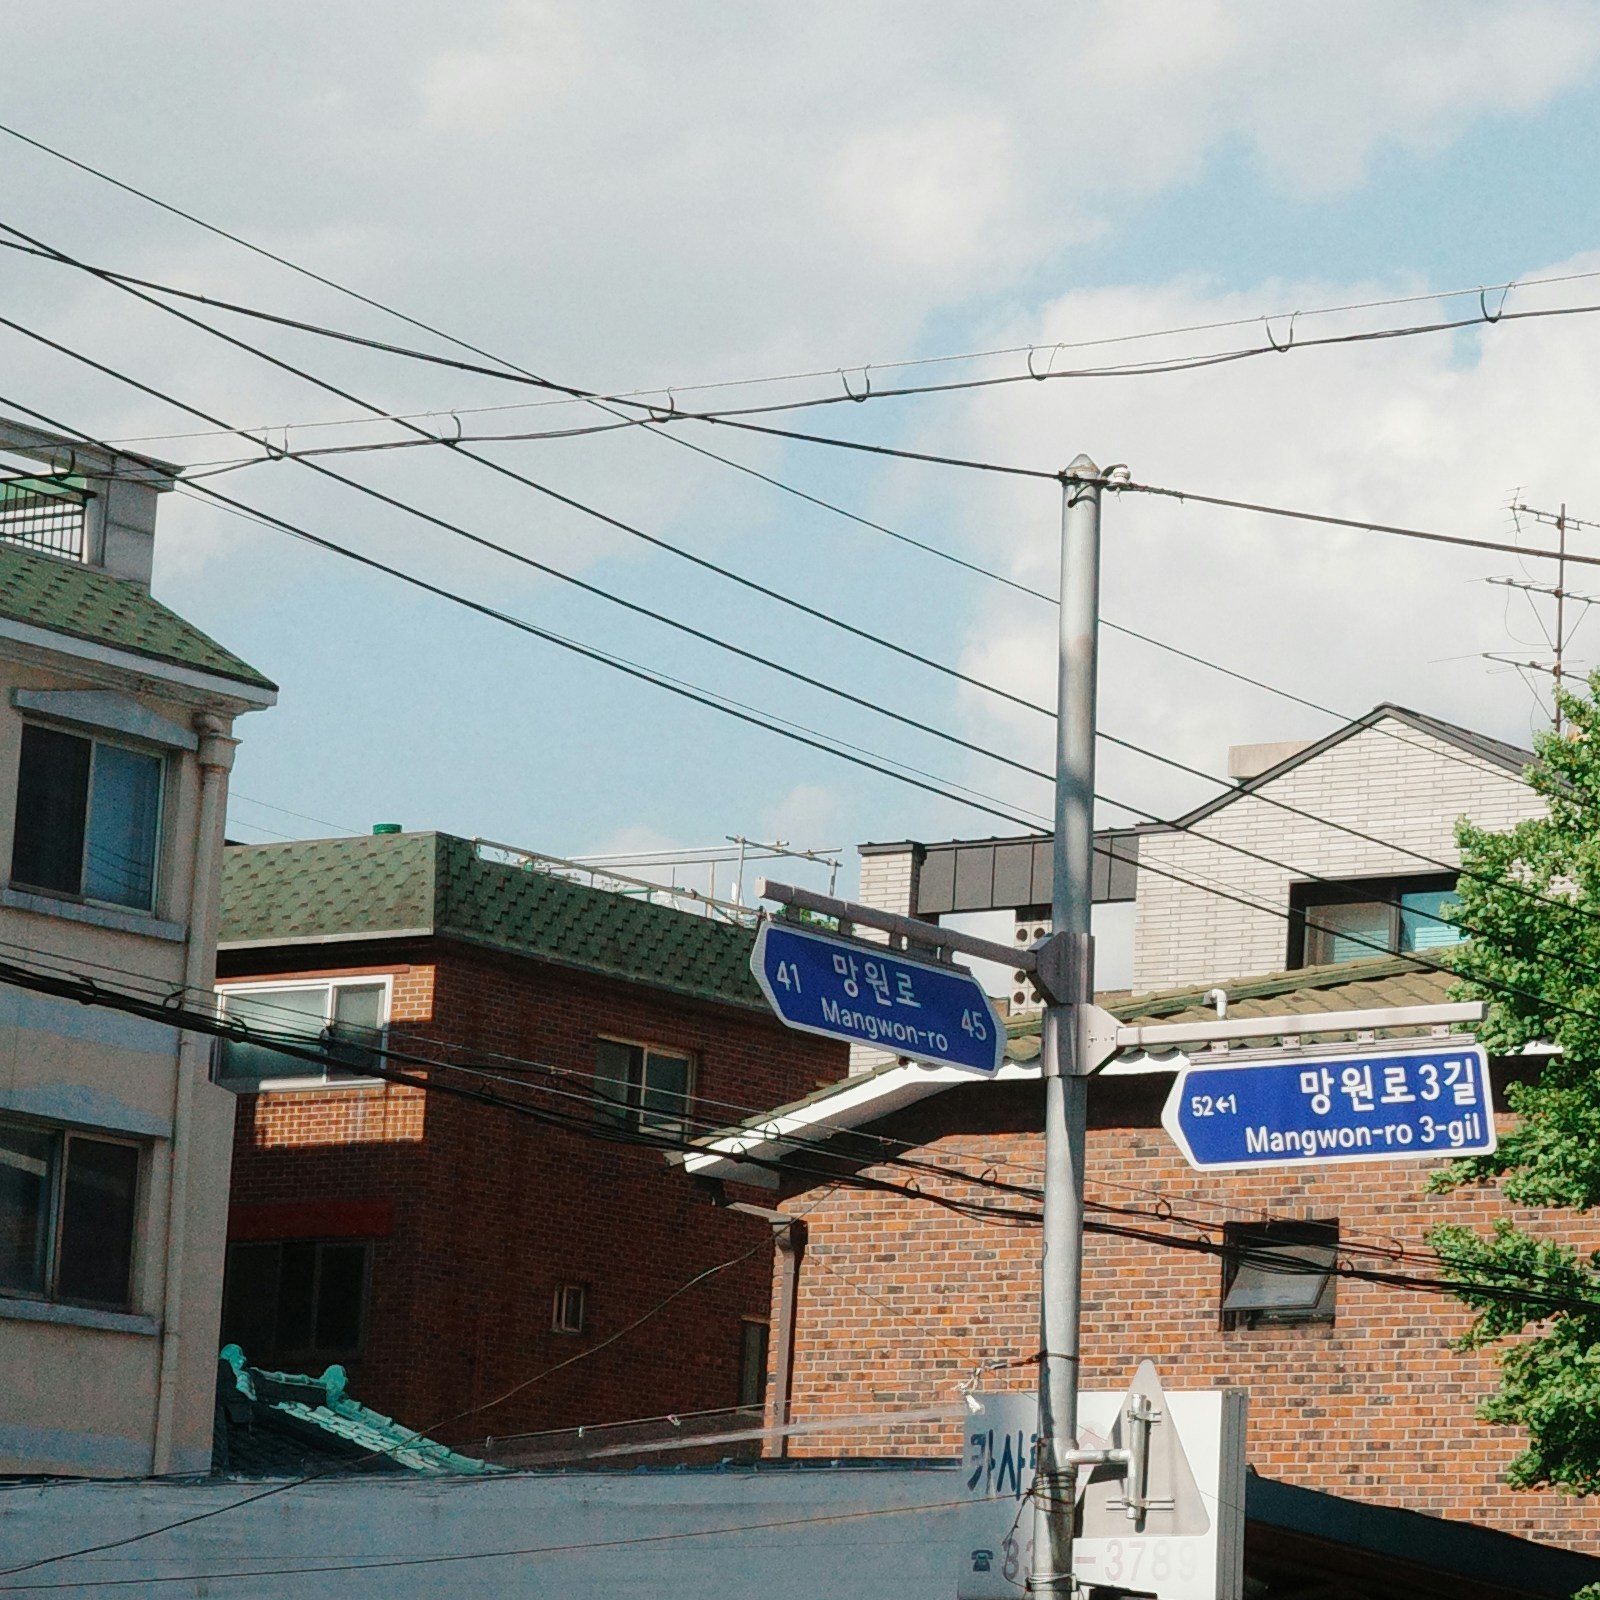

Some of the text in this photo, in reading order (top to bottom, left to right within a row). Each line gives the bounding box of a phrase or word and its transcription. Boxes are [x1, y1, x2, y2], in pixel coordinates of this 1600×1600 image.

[776, 960, 803, 995] 41
[833, 952, 922, 1009] 망원로
[821, 996, 950, 1054] Mangwon-ro
[960, 1008, 987, 1042] 45
[1191, 1094, 1215, 1118] 52
[1299, 1058, 1478, 1116] 망원로3길
[1245, 1111, 1481, 1155] Mangwon-ro 3-gil
